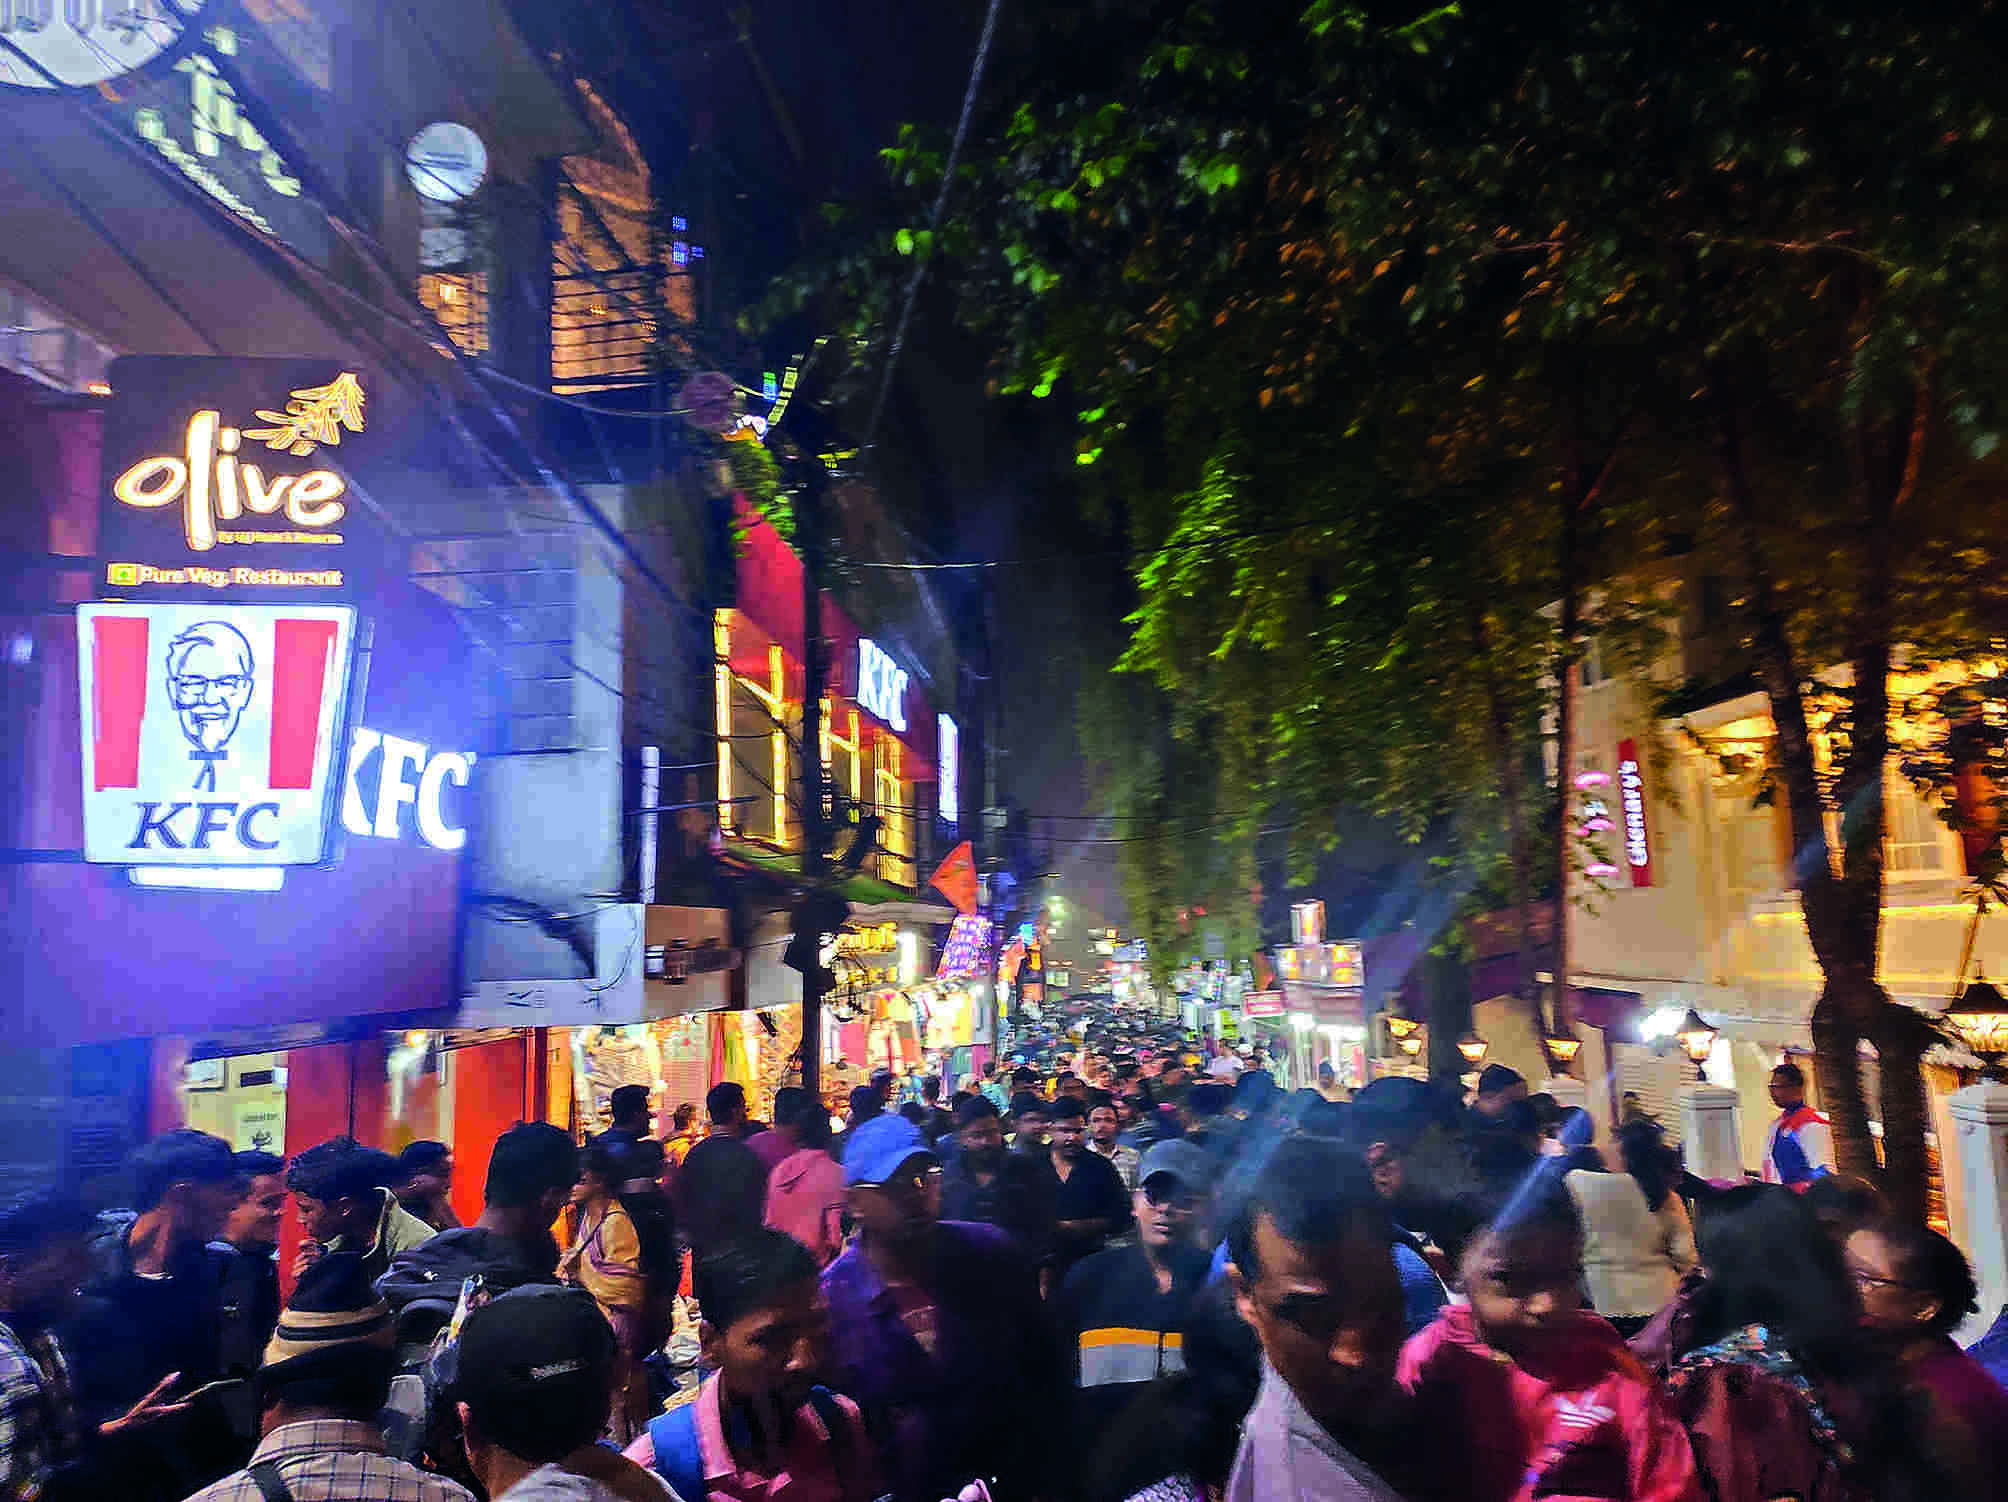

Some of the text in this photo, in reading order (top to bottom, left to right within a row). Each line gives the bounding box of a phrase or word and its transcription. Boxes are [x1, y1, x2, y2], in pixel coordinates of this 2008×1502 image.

[114, 410, 345, 551] olive
[857, 638, 907, 731] KFC
[125, 802, 281, 849] KFC
